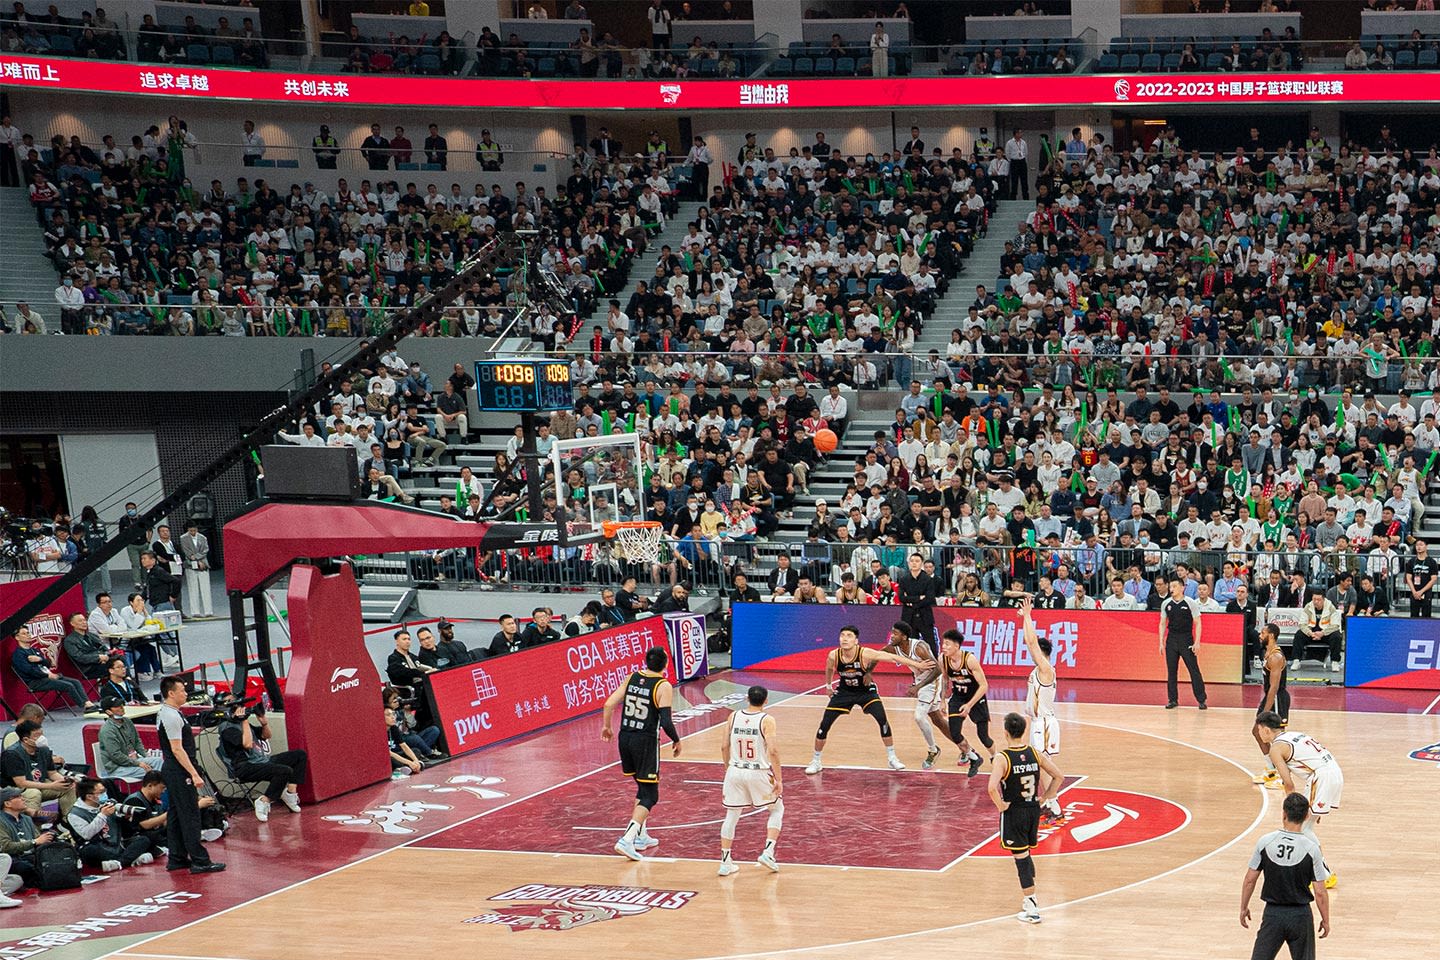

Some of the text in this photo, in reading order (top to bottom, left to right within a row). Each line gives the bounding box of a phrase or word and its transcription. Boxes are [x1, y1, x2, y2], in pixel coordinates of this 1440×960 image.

[0, 63, 60, 82] 难而上
[139, 72, 209, 91] 追求卓越
[284, 80, 350, 97] 共创未来
[740, 84, 789, 104] 当燃由我
[1136, 81, 1344, 96] 2022-2023 中国男子篮球职业联赛
[567, 628, 655, 673] CBA 联赛官方
[957, 619, 1078, 667] 当燃由我
[331, 678, 360, 693] LI-NING
[514, 695, 552, 719] 普华永道
[624, 694, 650, 720] 55
[453, 710, 493, 745] pwc
[737, 738, 755, 759] 15
[1020, 774, 1036, 799] 3
[1276, 844, 1295, 860] 37
